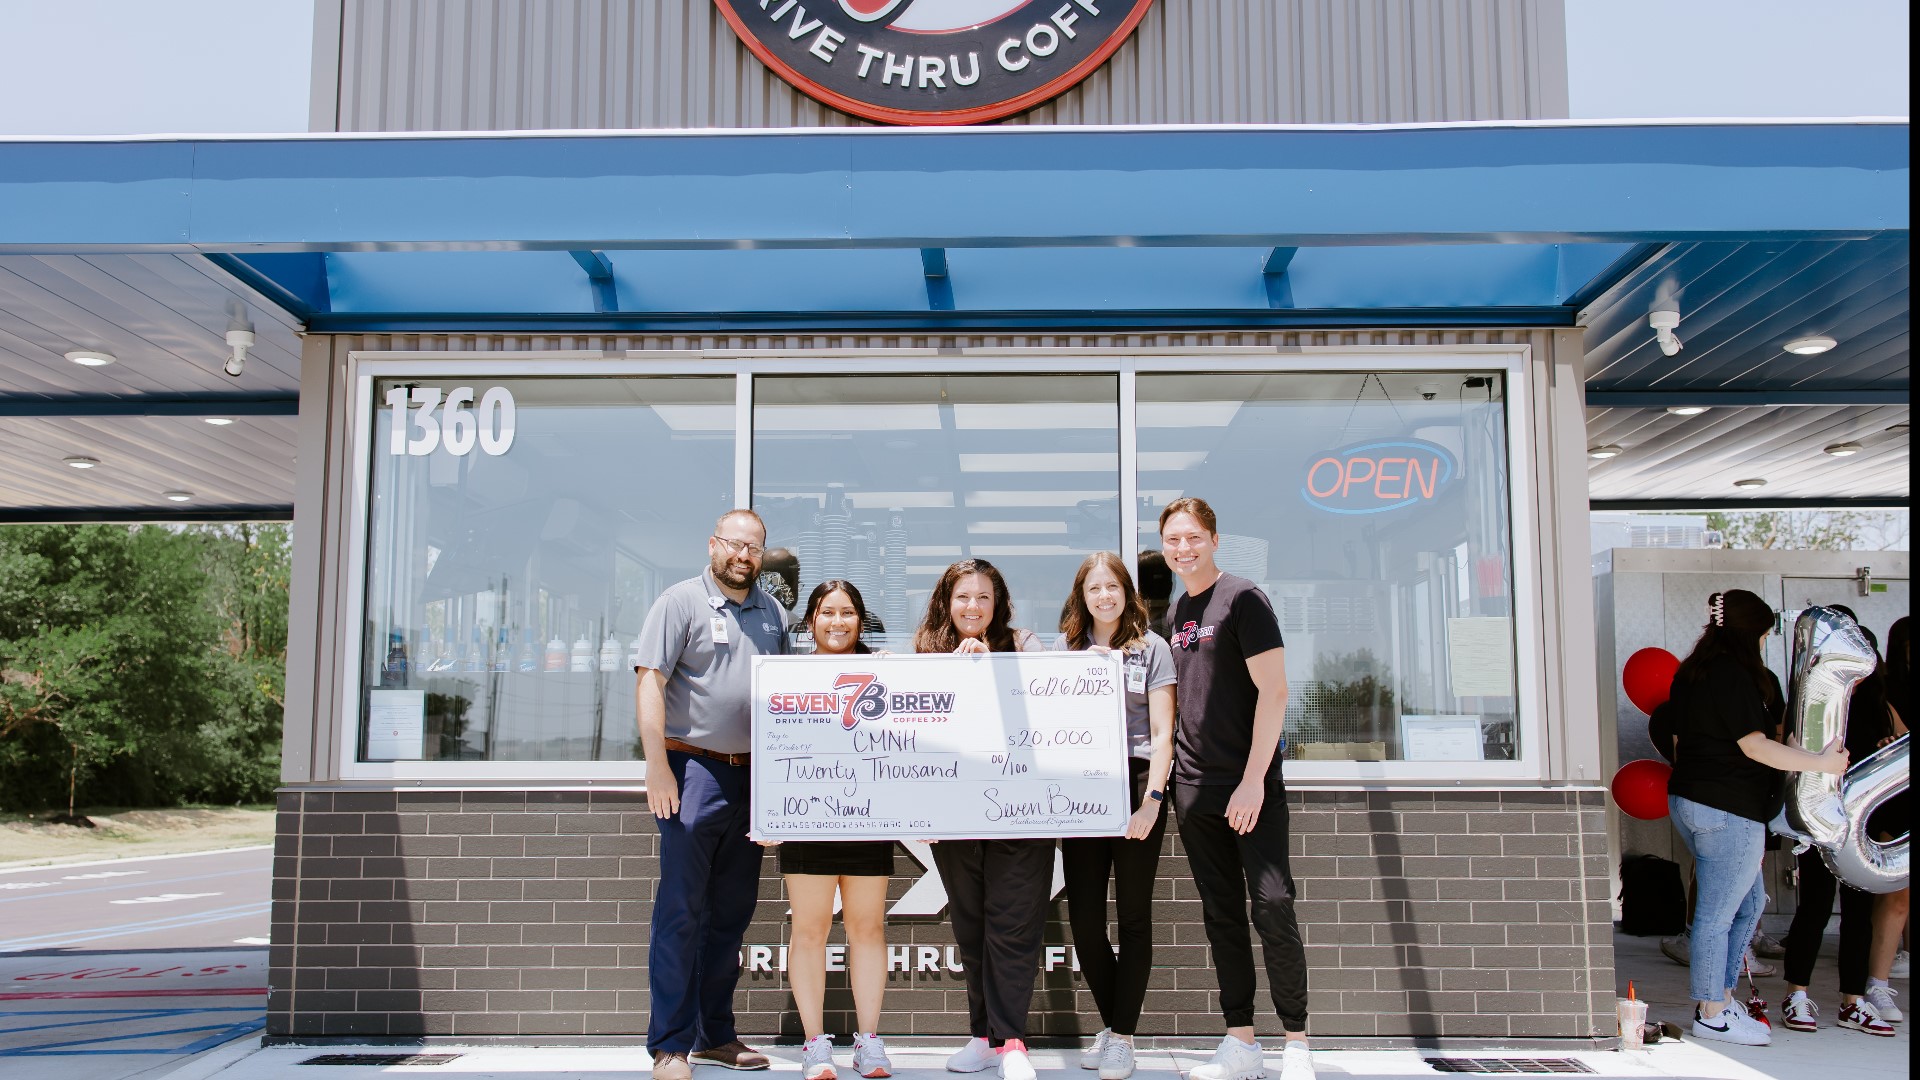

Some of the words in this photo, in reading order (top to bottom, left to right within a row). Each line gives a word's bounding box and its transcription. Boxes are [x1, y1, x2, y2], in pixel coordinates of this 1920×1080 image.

[857, 43, 981, 88] THRU
[386, 386, 516, 456] 1360
[1307, 457, 1439, 499] OPEN
[1086, 667, 1108, 676] 1001
[767, 693, 840, 714] SEVEN
[889, 692, 955, 713] BREW
[853, 729, 917, 752] CMNH
[774, 756, 858, 798] Twenty
[861, 755, 959, 782] Thousand
[824, 795, 871, 818] Stand
[983, 788, 1043, 822] Seven
[1046, 783, 1109, 815] Brew
[739, 946, 846, 972] RIE
[887, 946, 964, 972] HRU
